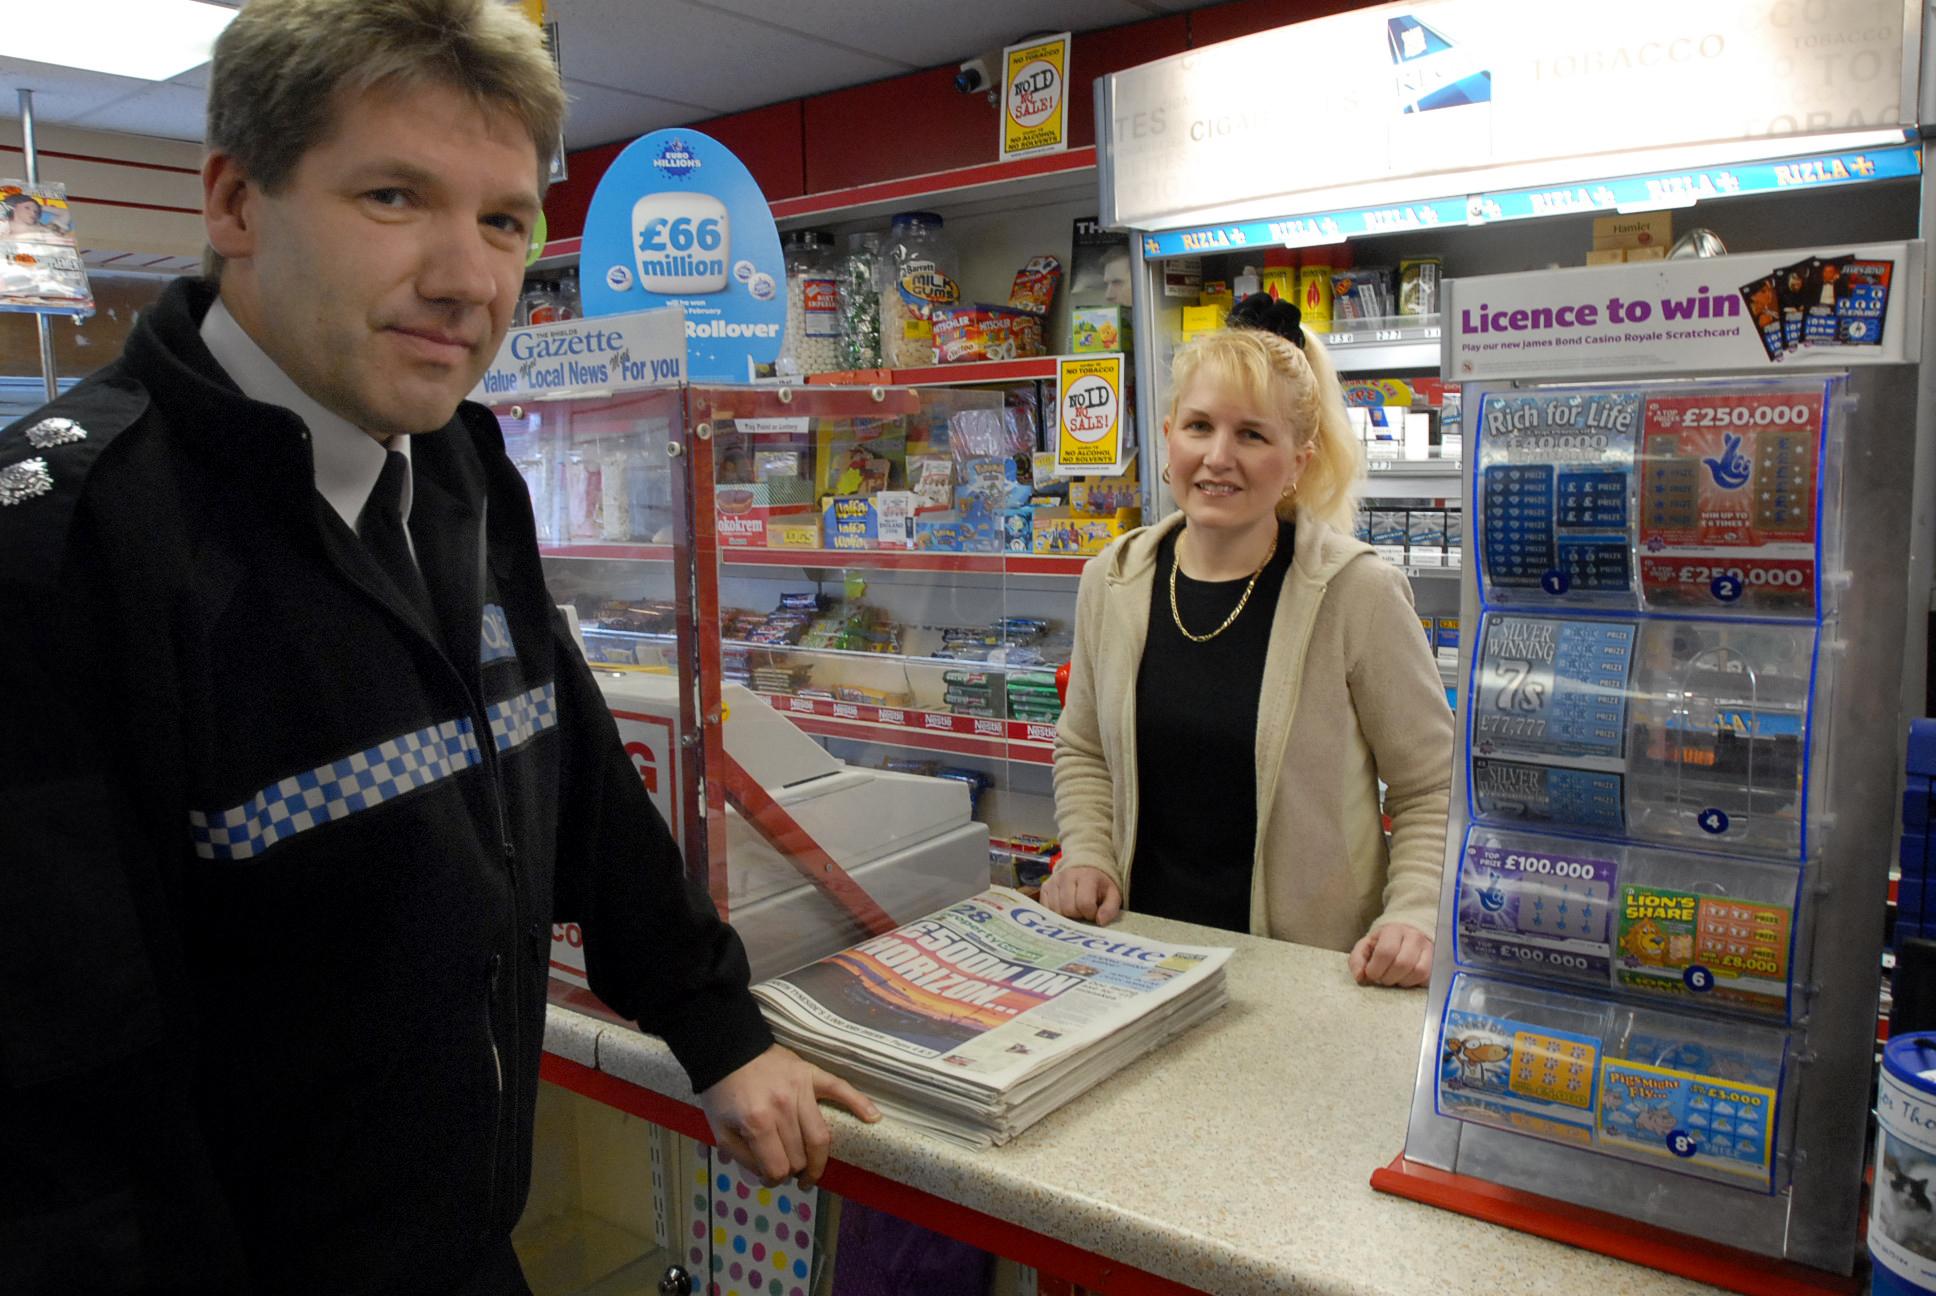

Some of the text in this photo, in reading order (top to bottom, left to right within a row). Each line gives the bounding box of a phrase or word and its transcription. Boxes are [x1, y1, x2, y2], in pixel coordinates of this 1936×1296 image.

[1793, 28, 1892, 49] TOBACCO
[1014, 68, 1054, 96] NO ID
[1015, 96, 1053, 119] SALE!
[1020, 92, 1033, 104] NO
[653, 160, 701, 168] MILLIONS
[1613, 221, 1651, 234] Hamlet
[642, 254, 722, 276] million
[912, 274, 952, 289] MILK
[1462, 286, 1740, 334] Licence to win
[686, 320, 779, 338] Rollover
[1462, 326, 1740, 352] Play our new James Bond Casino Royale Scratchcard
[511, 330, 624, 361] Gazette
[484, 368, 517, 394] Value
[528, 361, 565, 390] Local
[569, 361, 608, 386] News
[623, 358, 646, 382] For
[651, 357, 680, 384] you
[1068, 385, 1109, 409] NO ID
[1075, 406, 1088, 418] NO
[1487, 401, 1632, 437] Rich for Life
[1681, 405, 1809, 427] £250,000
[1070, 415, 1109, 432] SALE!
[1549, 577, 1560, 590] 1
[1720, 582, 1733, 596] 2
[1503, 623, 1552, 643] SILVER
[1489, 638, 1555, 664] WINNING
[1496, 659, 1544, 712] 7s
[1481, 714, 1545, 737] £77,777
[1489, 767, 1539, 788] SILVER
[1706, 814, 1720, 829] 4
[1479, 859, 1501, 868] PRIZE
[1484, 851, 1500, 859] TOP
[1626, 895, 1697, 909] LION'S
[950, 904, 993, 925] 28
[1625, 906, 1694, 921] SHARE
[1010, 907, 1166, 963] Gazette
[1722, 955, 1777, 973] £8,000
[856, 936, 1019, 1015] HORIZON...
[1010, 968, 1084, 997] ON
[1691, 971, 1705, 987] 6
[1675, 1136, 1688, 1151] 8
